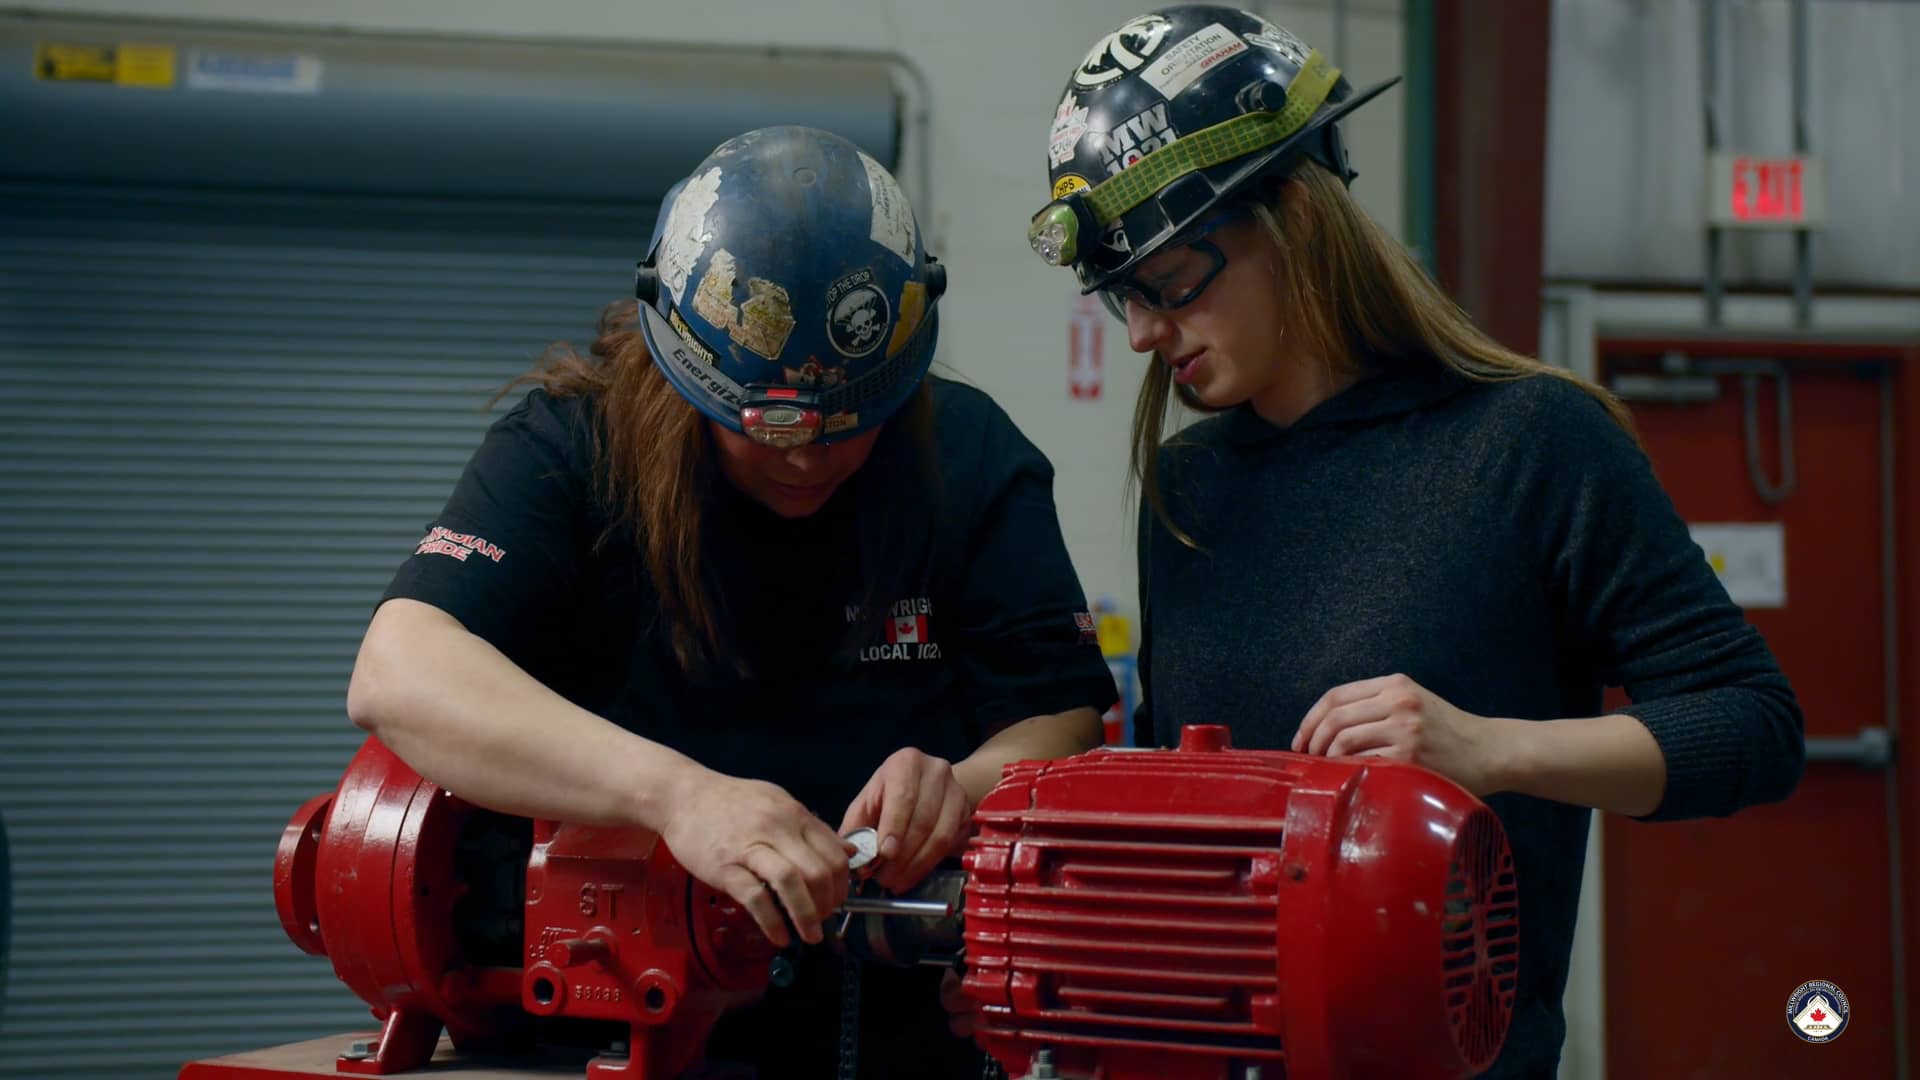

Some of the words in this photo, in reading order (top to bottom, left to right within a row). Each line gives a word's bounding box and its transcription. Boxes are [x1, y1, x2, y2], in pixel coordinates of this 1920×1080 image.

[1200, 42, 1242, 69] GRAHAM
[1101, 103, 1169, 164] MW
[1731, 160, 1805, 219] EXIT
[837, 279, 853, 294] THE
[672, 348, 742, 406] Energiz
[861, 643, 911, 661] LOCAL
[579, 882, 624, 920] ST
